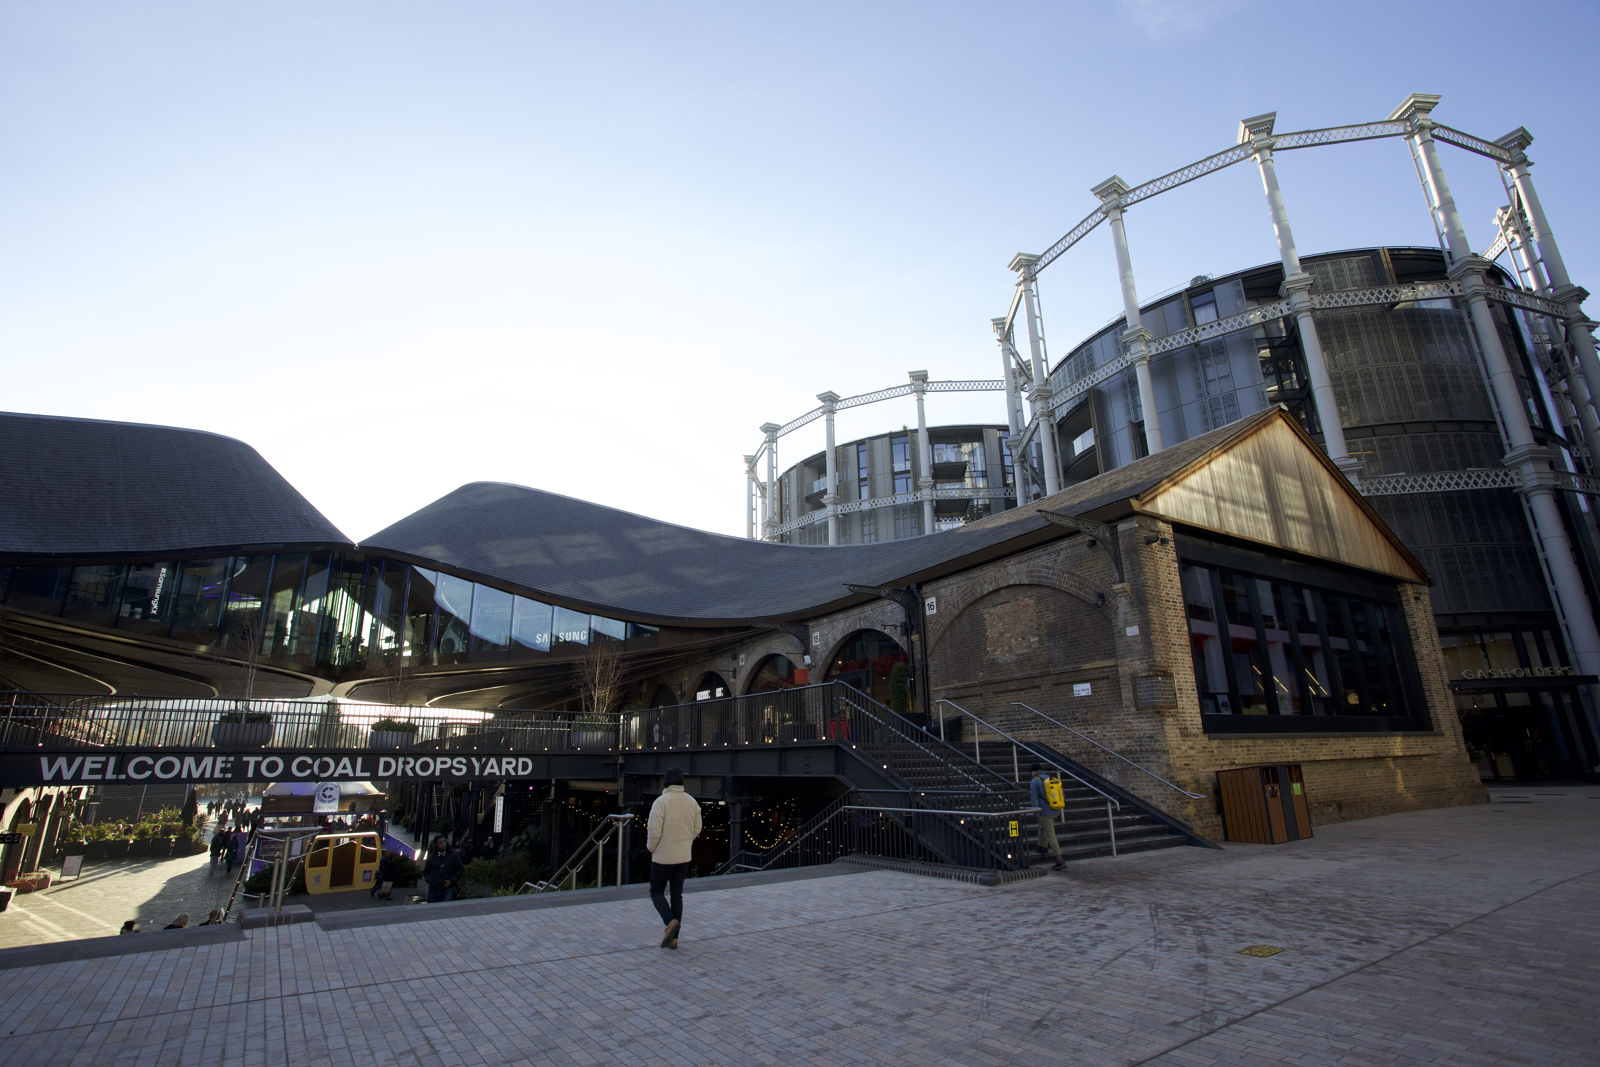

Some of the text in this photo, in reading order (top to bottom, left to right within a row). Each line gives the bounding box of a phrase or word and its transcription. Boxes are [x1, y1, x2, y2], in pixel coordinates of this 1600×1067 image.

[150, 567, 167, 615] #SamsungKX
[926, 601, 935, 611] 16
[1462, 665, 1574, 680] GASHOLDERS
[40, 756, 533, 781] WELCOME TO COAL DROPS YARD
[1010, 822, 1018, 835] H
